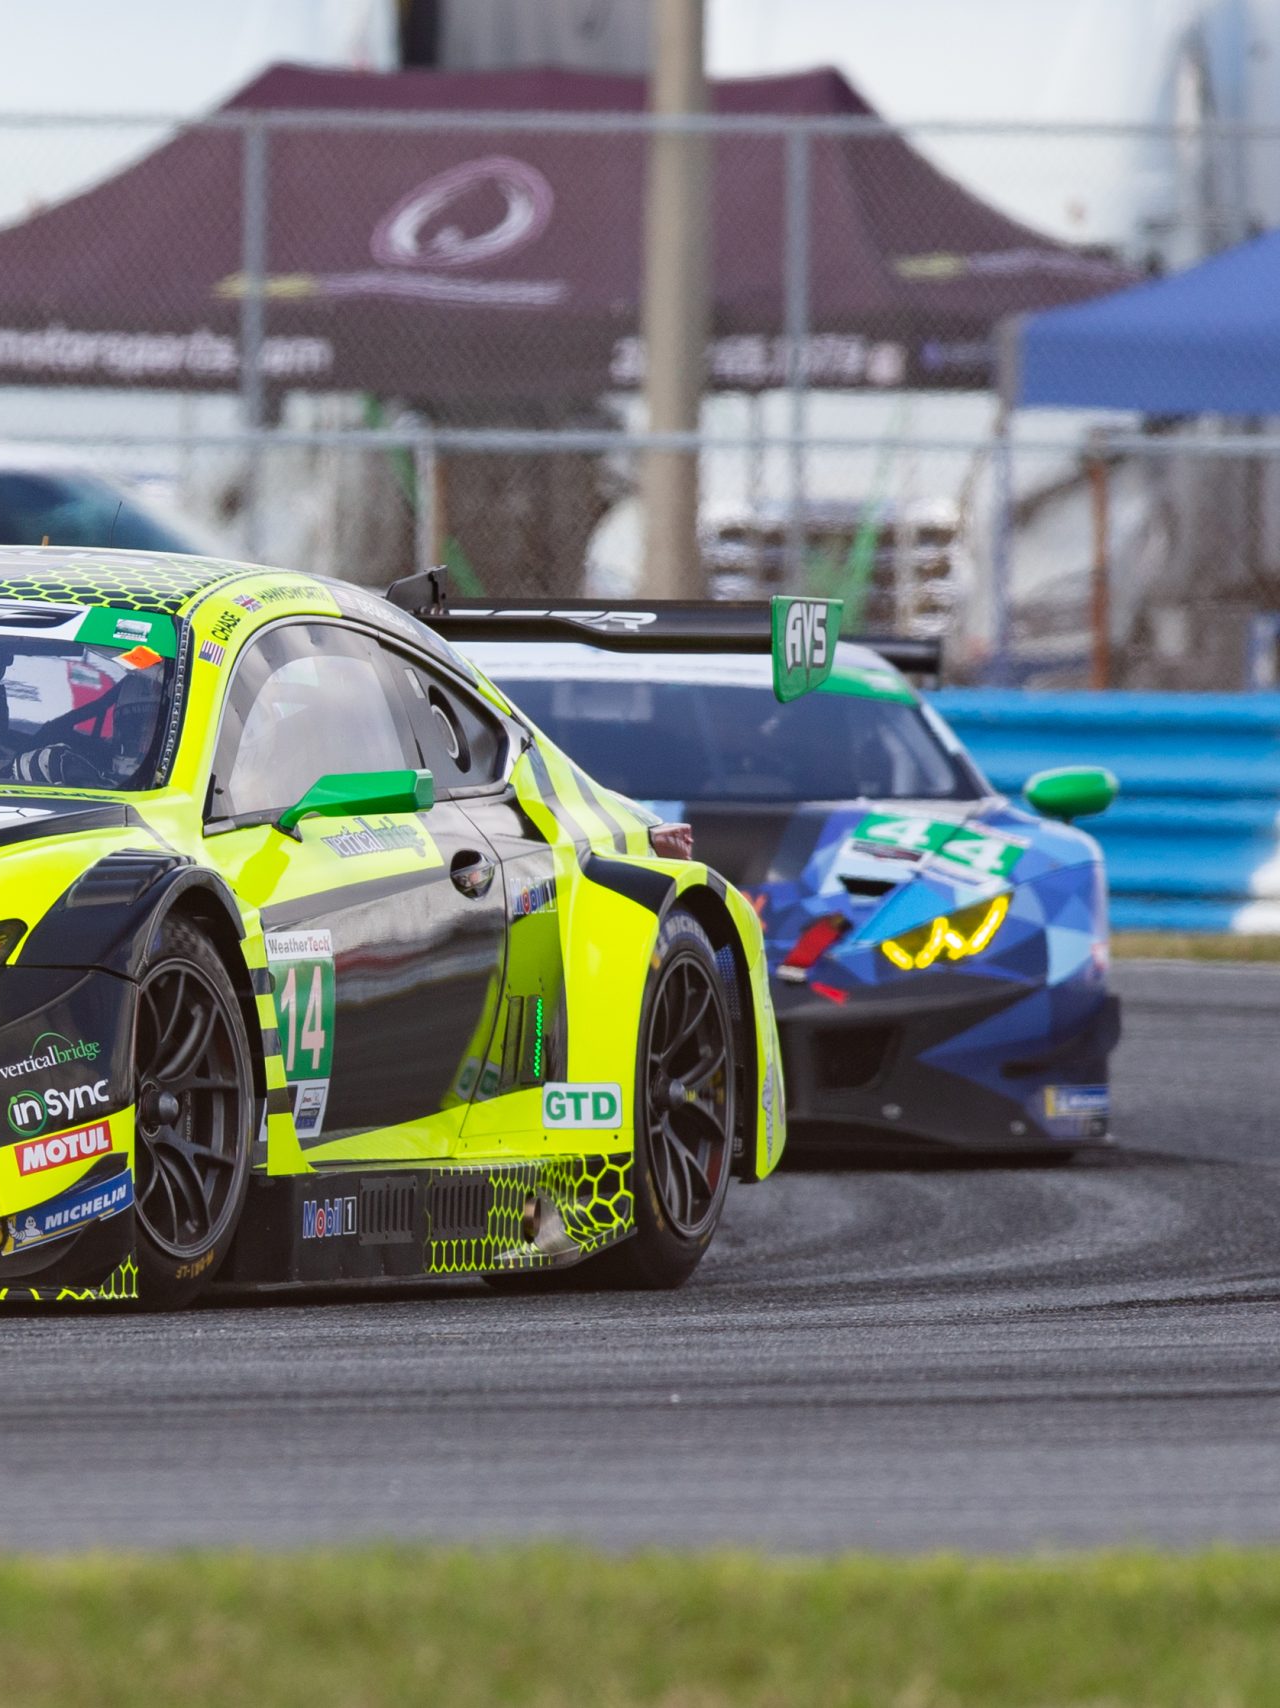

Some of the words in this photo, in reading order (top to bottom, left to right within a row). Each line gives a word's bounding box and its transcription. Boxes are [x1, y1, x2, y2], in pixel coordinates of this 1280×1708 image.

[211, 611, 241, 641] CHASE
[785, 602, 828, 670] AVS
[268, 937, 331, 955] WeatherTech
[280, 965, 326, 1073] 14
[545, 1090, 618, 1121] GTD
[22, 1126, 110, 1172] MOTUL
[44, 1183, 127, 1231] MICHELIN
[302, 1198, 343, 1239] Mobil
